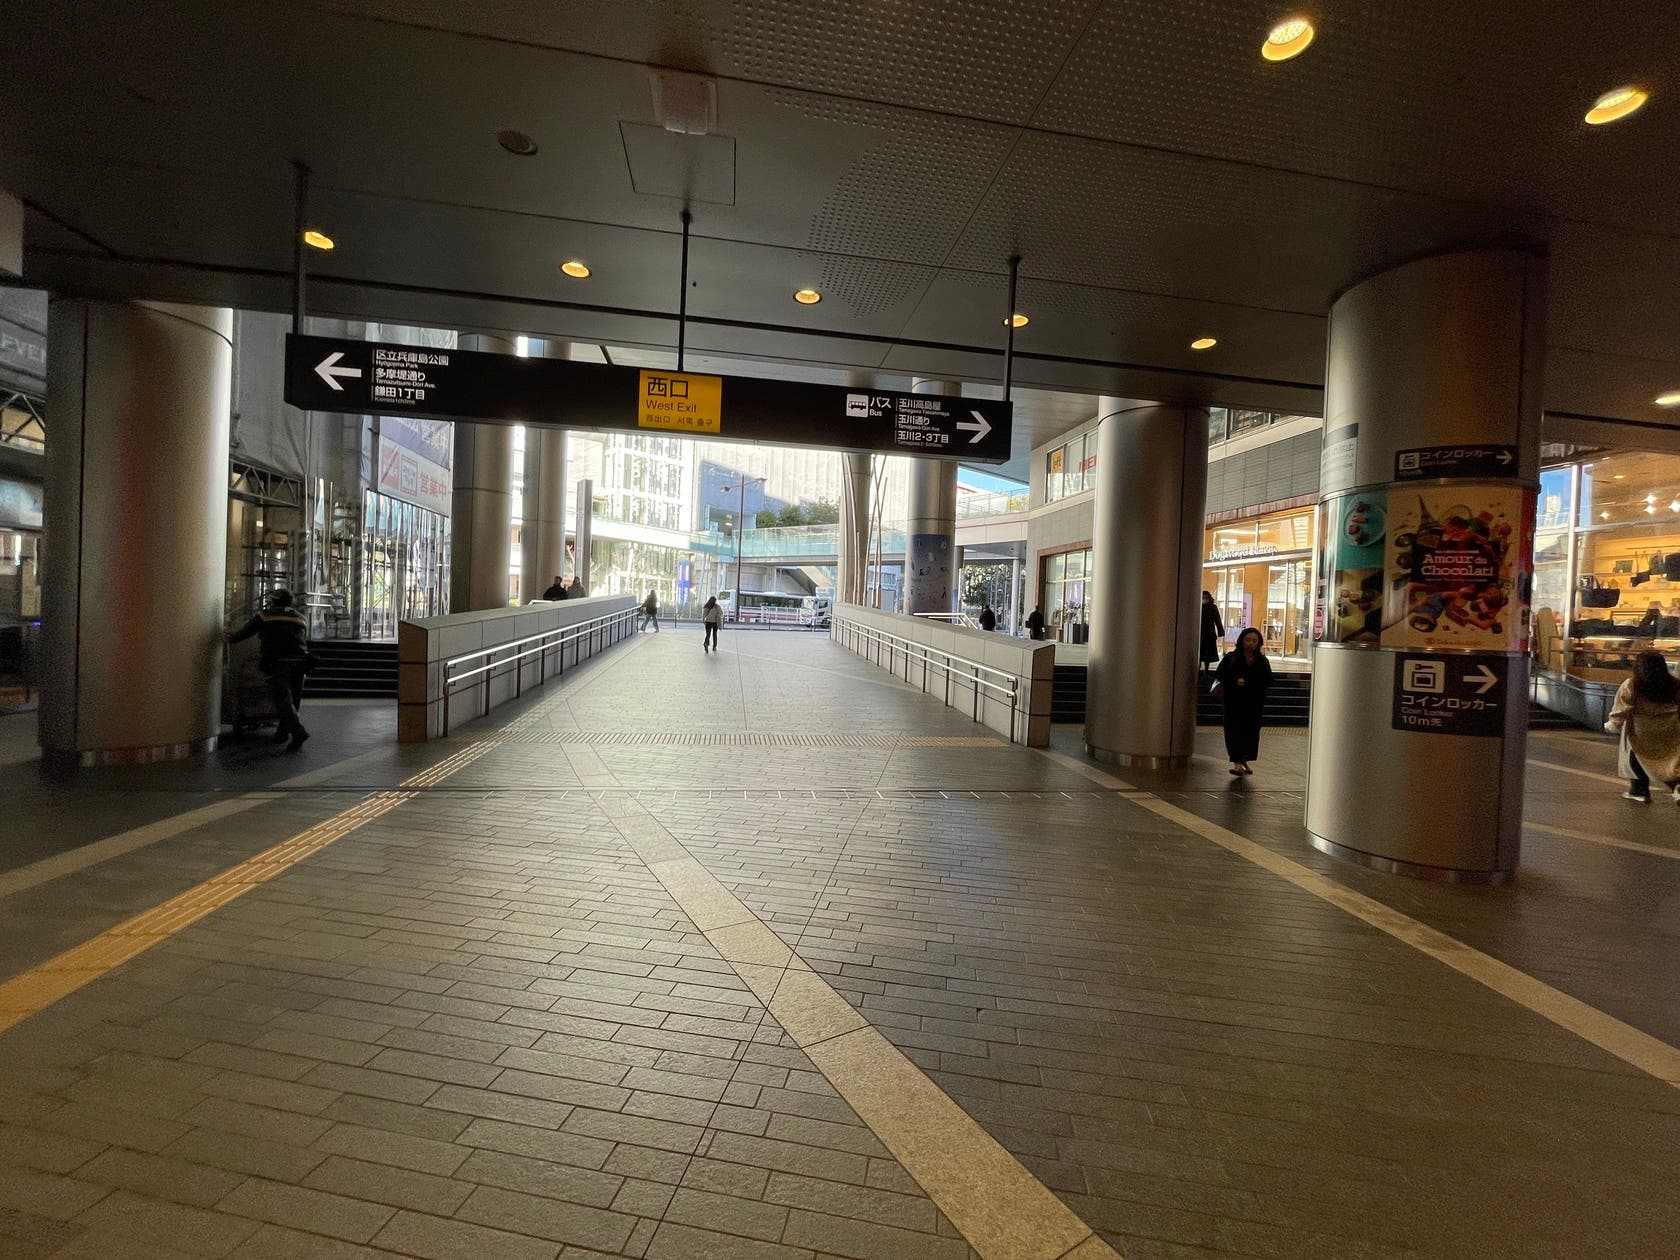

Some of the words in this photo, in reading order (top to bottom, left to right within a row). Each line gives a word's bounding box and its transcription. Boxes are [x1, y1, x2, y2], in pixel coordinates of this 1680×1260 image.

[376, 349, 449, 366] 区立兵庫島公園
[375, 367, 426, 381] 多摩堤通り
[647, 376, 688, 399] 西口
[646, 399, 673, 411] West
[677, 401, 697, 413] Exit
[870, 396, 892, 409] バス
[899, 398, 941, 411] 玉川高島屋
[869, 408, 883, 417] Bus
[898, 414, 930, 426] 玉川通り
[1421, 449, 1493, 460] コインロッカー
[1422, 553, 1474, 564] Amour
[1401, 694, 1498, 710] コインロッカー
[1402, 715, 1443, 727] 10m先
